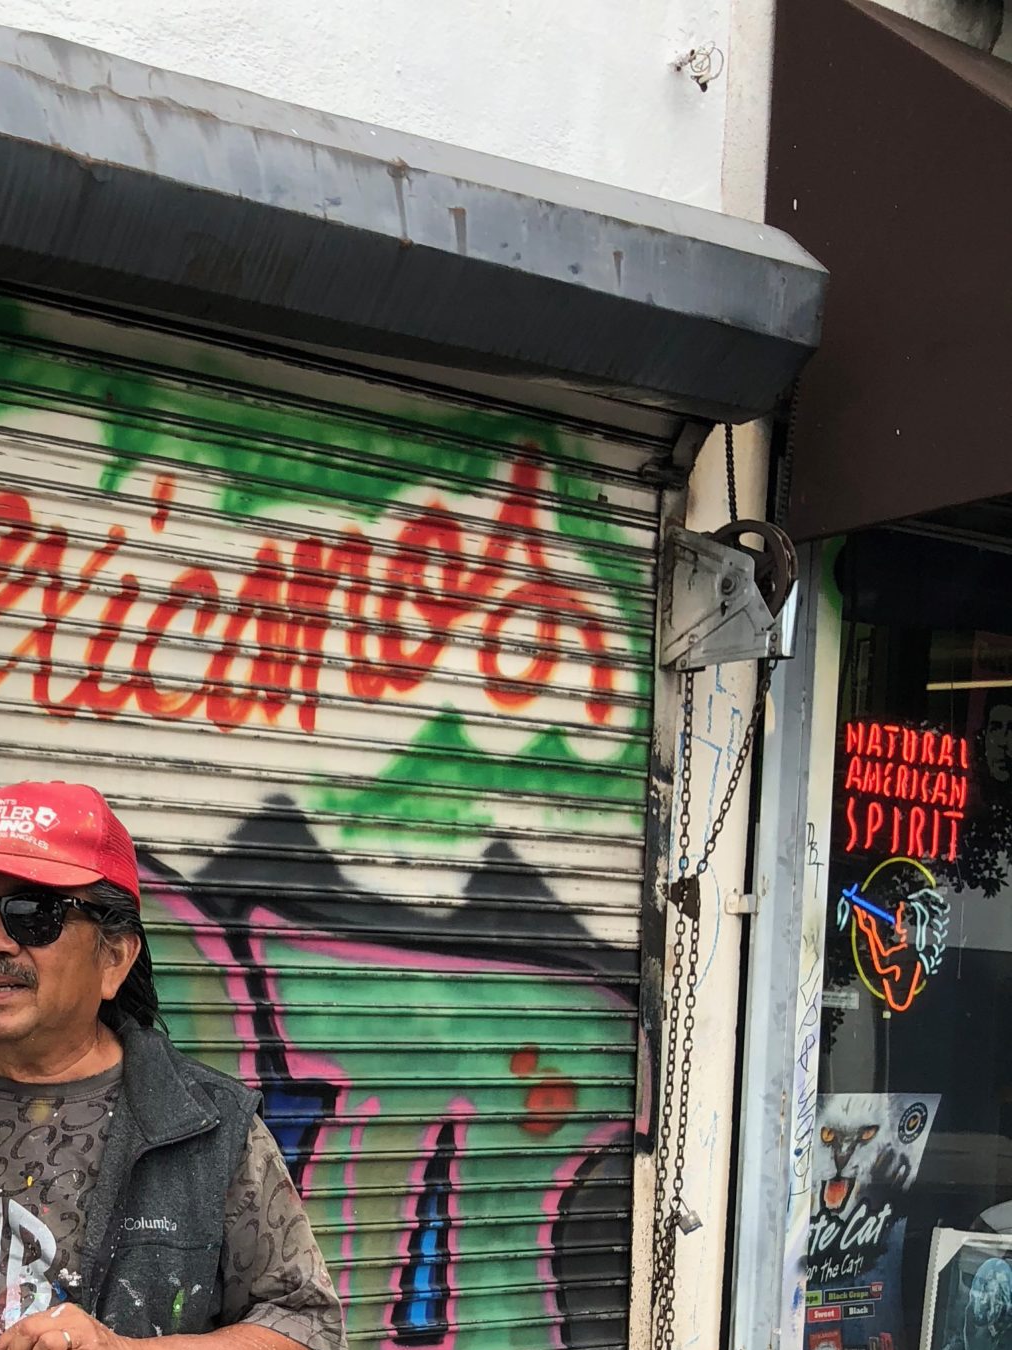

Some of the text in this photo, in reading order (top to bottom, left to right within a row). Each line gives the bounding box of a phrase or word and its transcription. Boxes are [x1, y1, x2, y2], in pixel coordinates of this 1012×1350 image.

[847, 722, 968, 769] NATURAL
[845, 756, 967, 808] AMERICAN
[845, 797, 964, 862] SPIRIT
[840, 1203, 892, 1250] Cat
[820, 1257, 839, 1282] the
[841, 1253, 864, 1277] Cat!
[814, 1310, 834, 1319] Sweet
[828, 1291, 847, 1300] Black
[849, 1306, 868, 1315] Black
